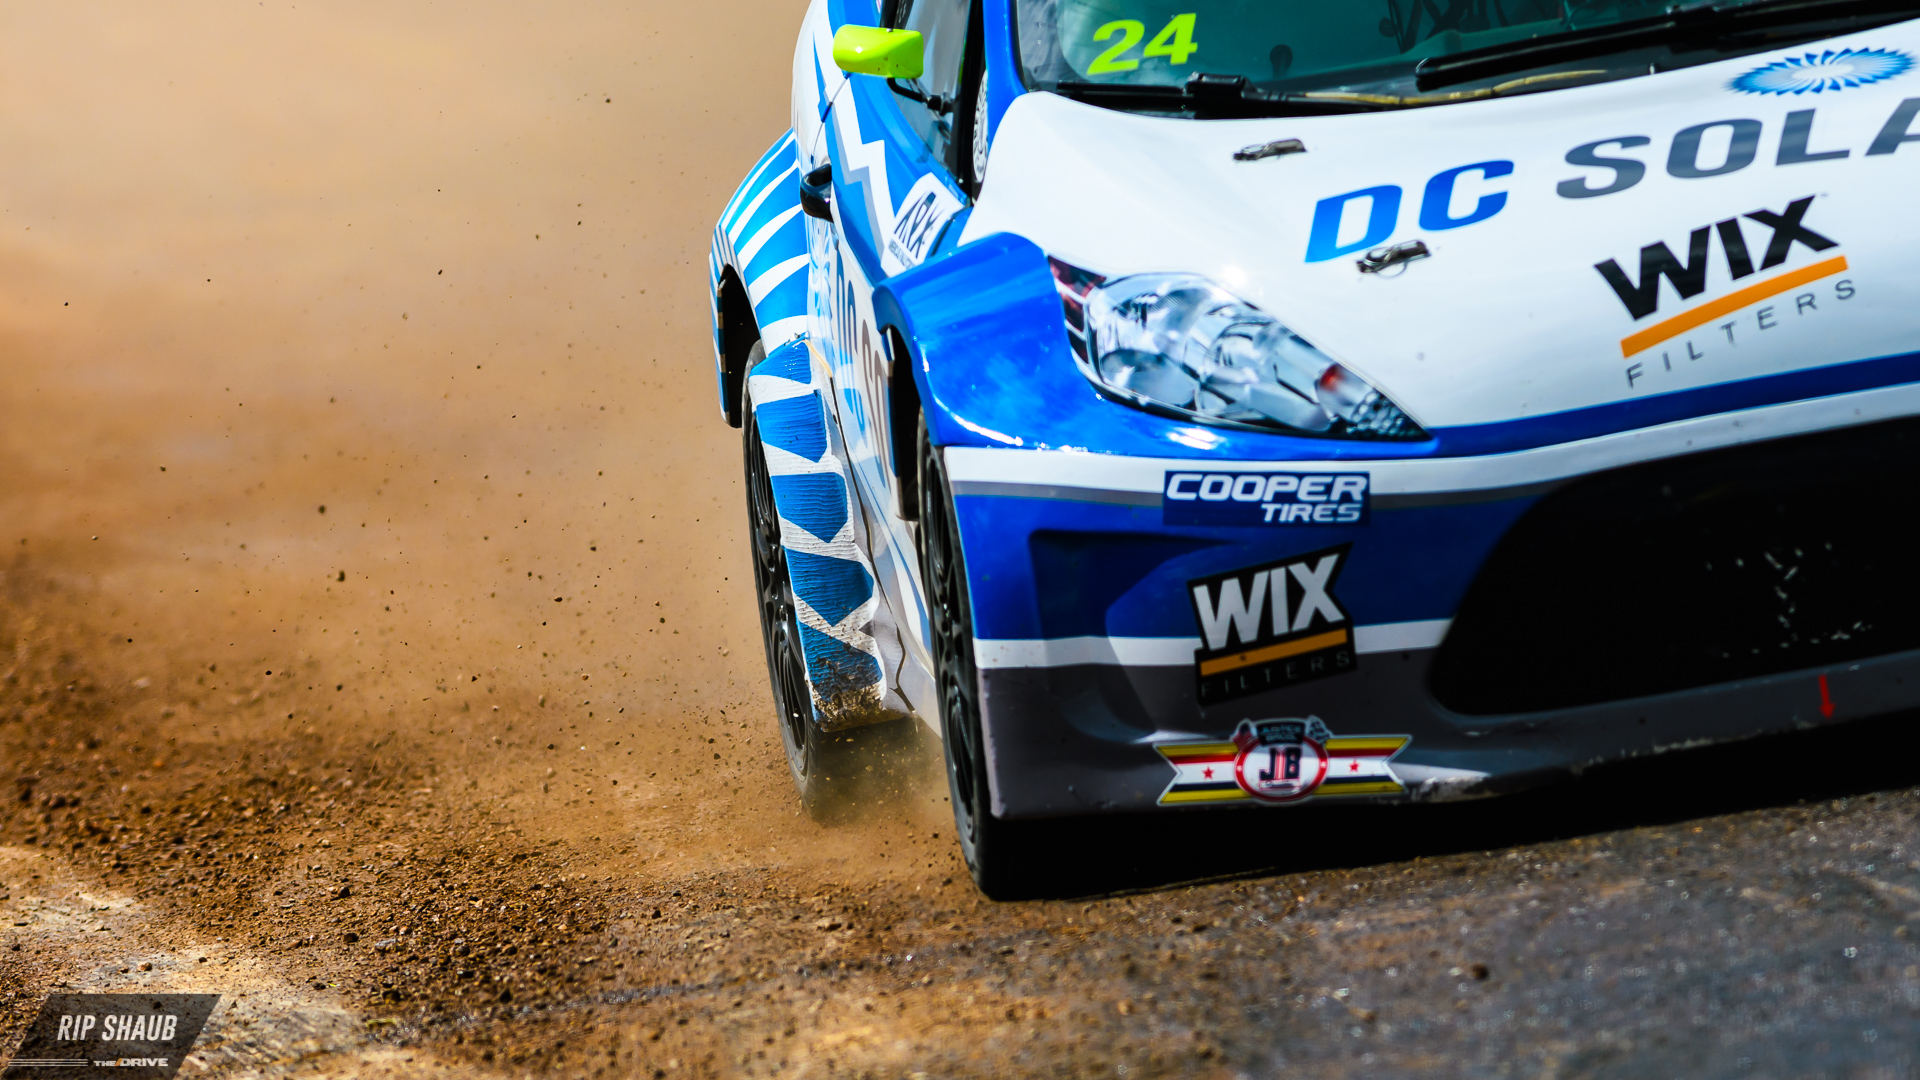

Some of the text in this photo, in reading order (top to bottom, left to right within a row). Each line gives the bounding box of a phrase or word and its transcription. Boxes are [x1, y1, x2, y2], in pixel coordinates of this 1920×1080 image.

[1086, 13, 1198, 76] 24
[1305, 160, 1514, 262] DC
[1594, 195, 1839, 320] WIX
[1627, 279, 1856, 388] FILTERS
[1166, 473, 1367, 501] COOPER
[1261, 503, 1362, 523] TIRES
[1193, 554, 1345, 651] WIX
[1201, 650, 1350, 698] FILTERS
